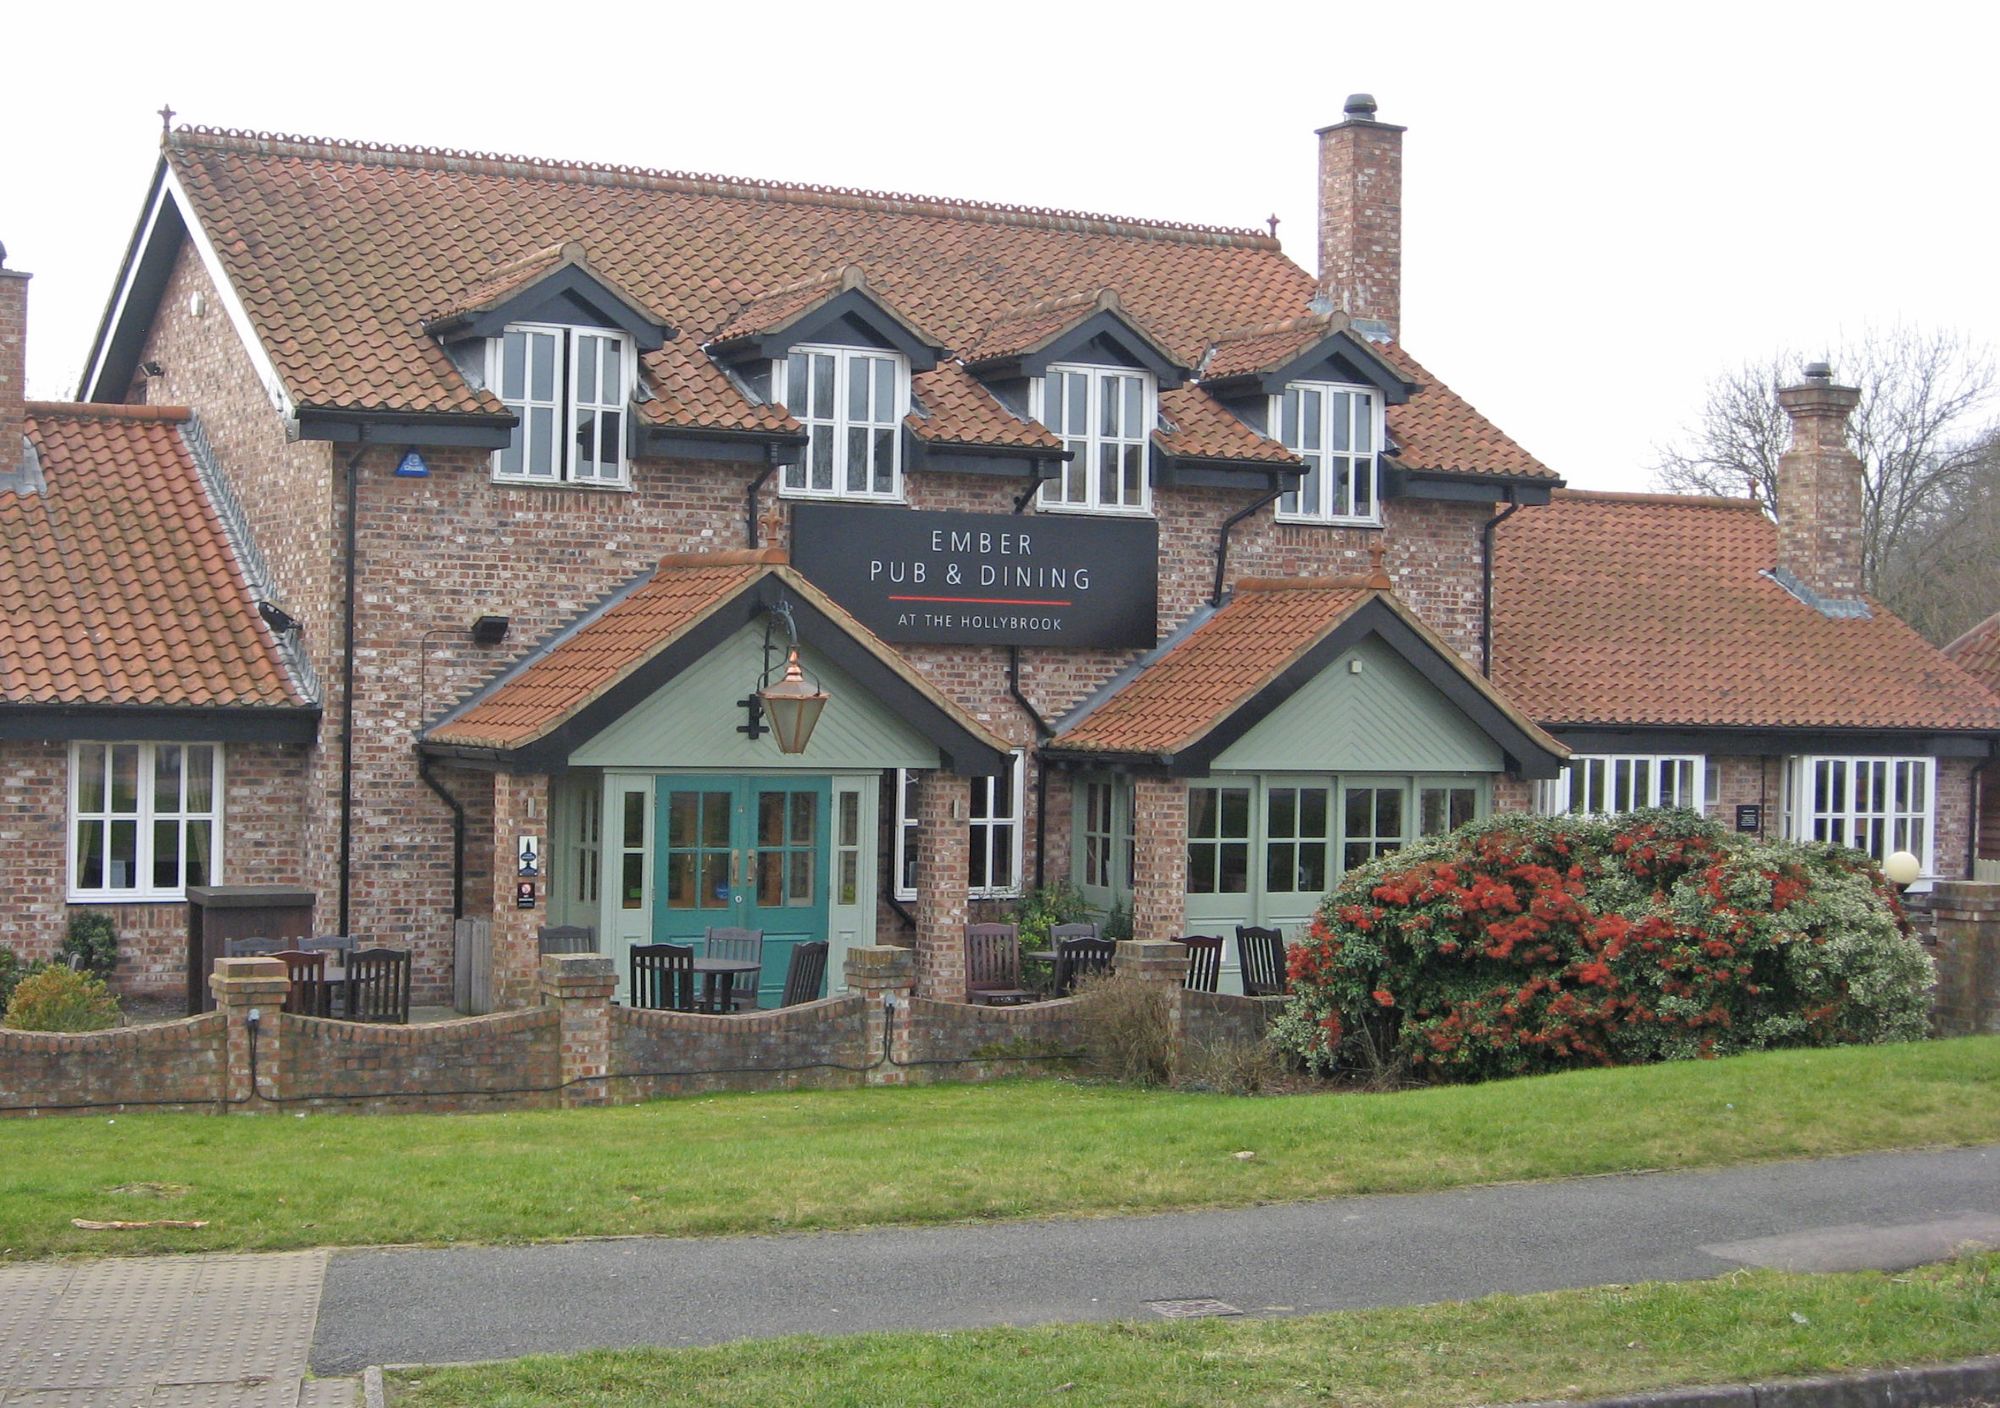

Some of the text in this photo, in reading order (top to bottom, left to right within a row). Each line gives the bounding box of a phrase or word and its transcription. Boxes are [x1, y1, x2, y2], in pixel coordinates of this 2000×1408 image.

[931, 530, 1031, 555] EMBER
[869, 560, 1090, 590] PUB & DINING
[897, 613, 1062, 631] AT THE HOLLYBROOK
